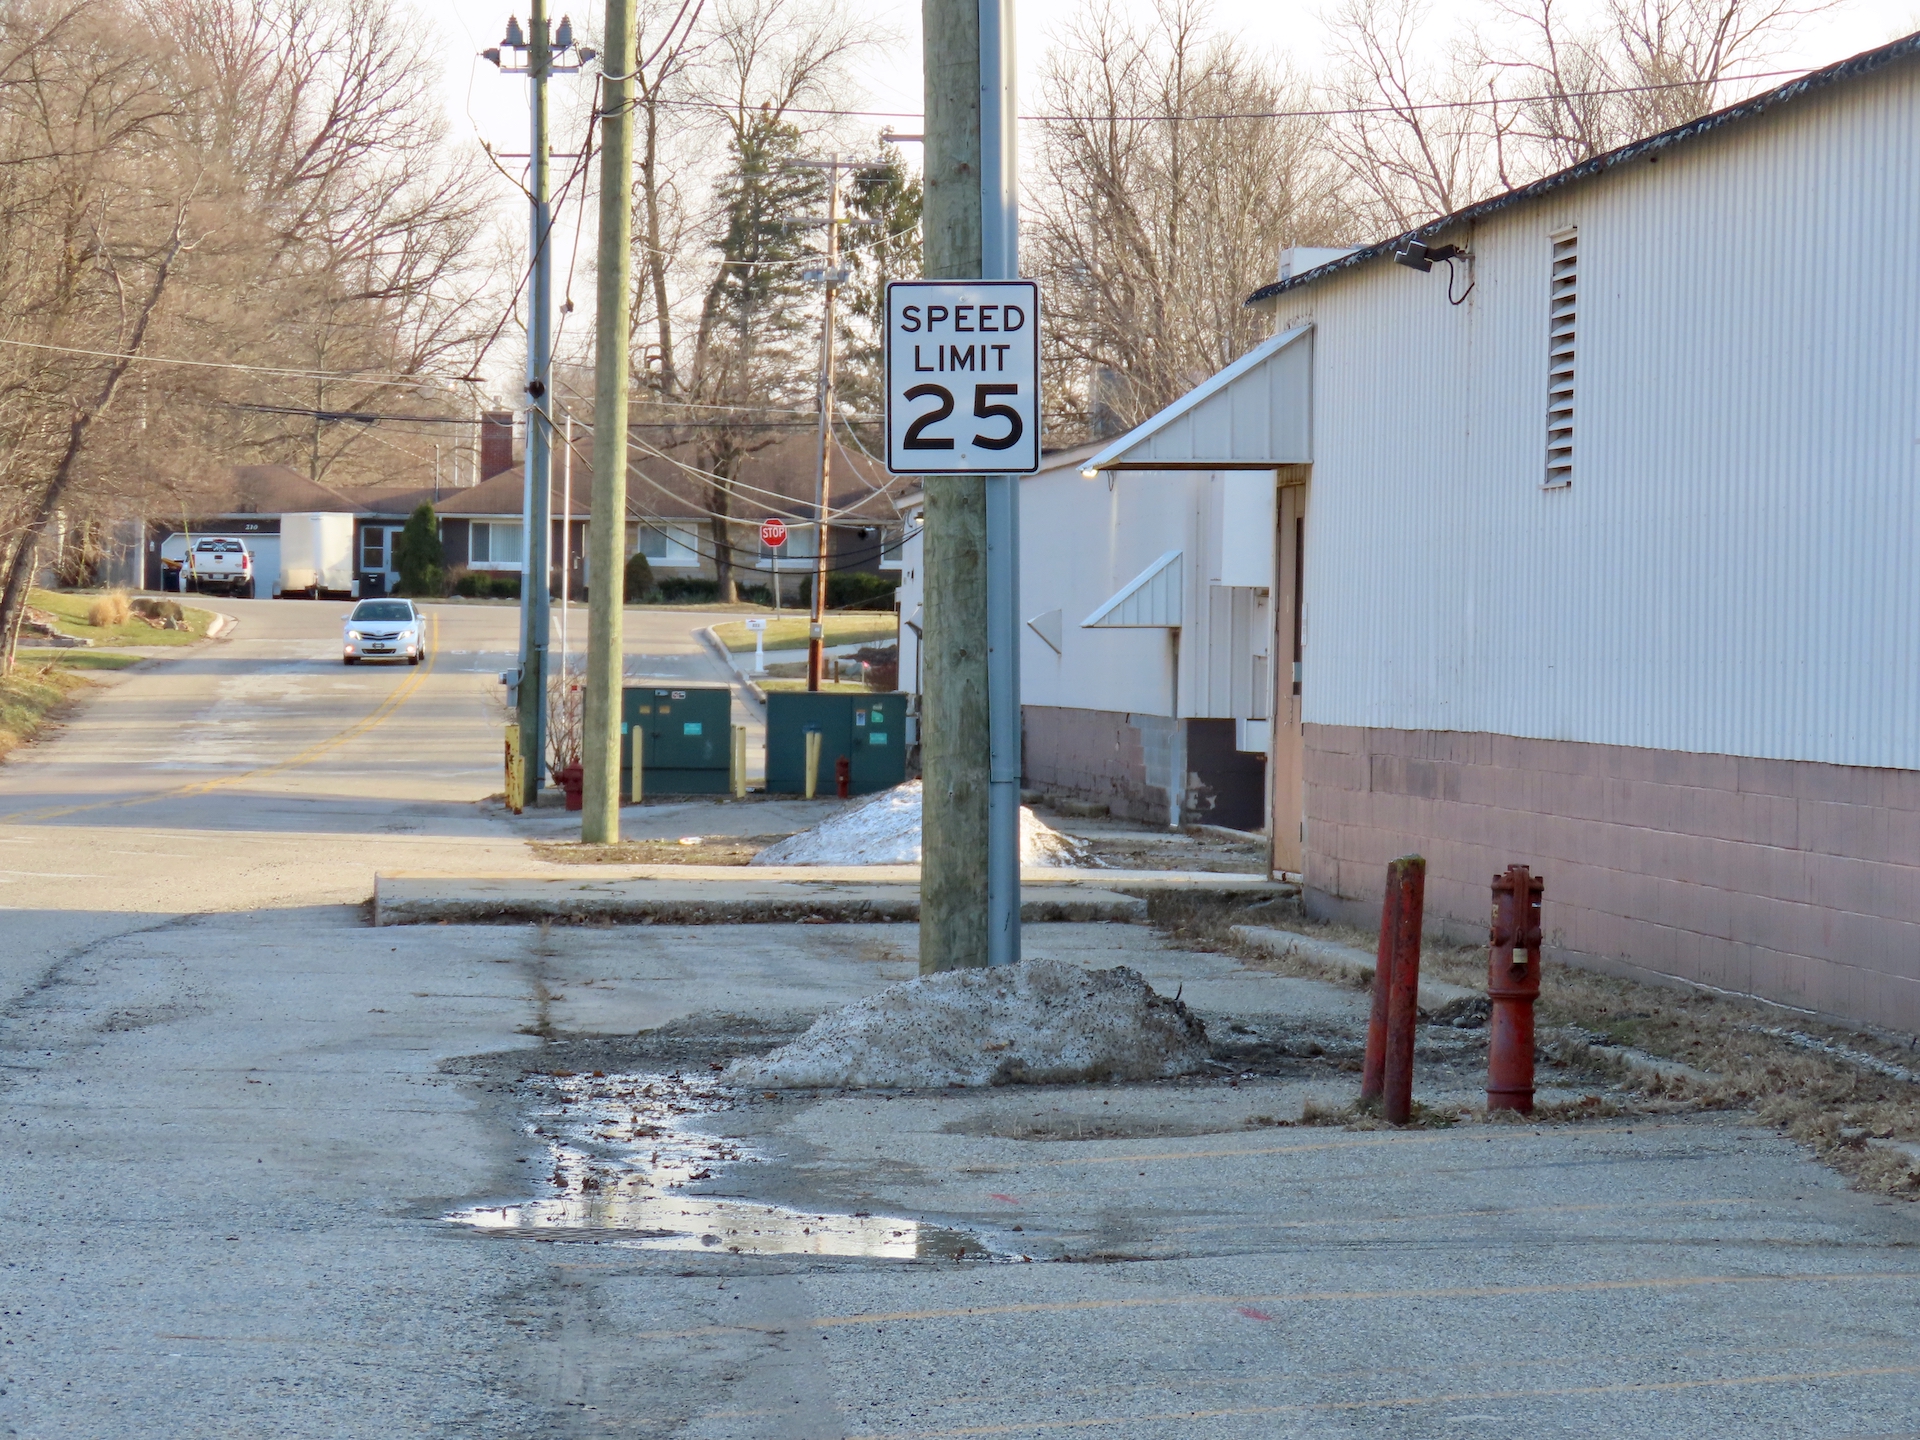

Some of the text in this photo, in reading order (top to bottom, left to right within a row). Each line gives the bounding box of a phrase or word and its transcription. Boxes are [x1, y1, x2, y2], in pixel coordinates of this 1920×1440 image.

[901, 305, 1025, 333] SPEED
[915, 345, 1010, 372] LIMIT
[903, 383, 1023, 450] 25
[763, 527, 785, 538] STOP
